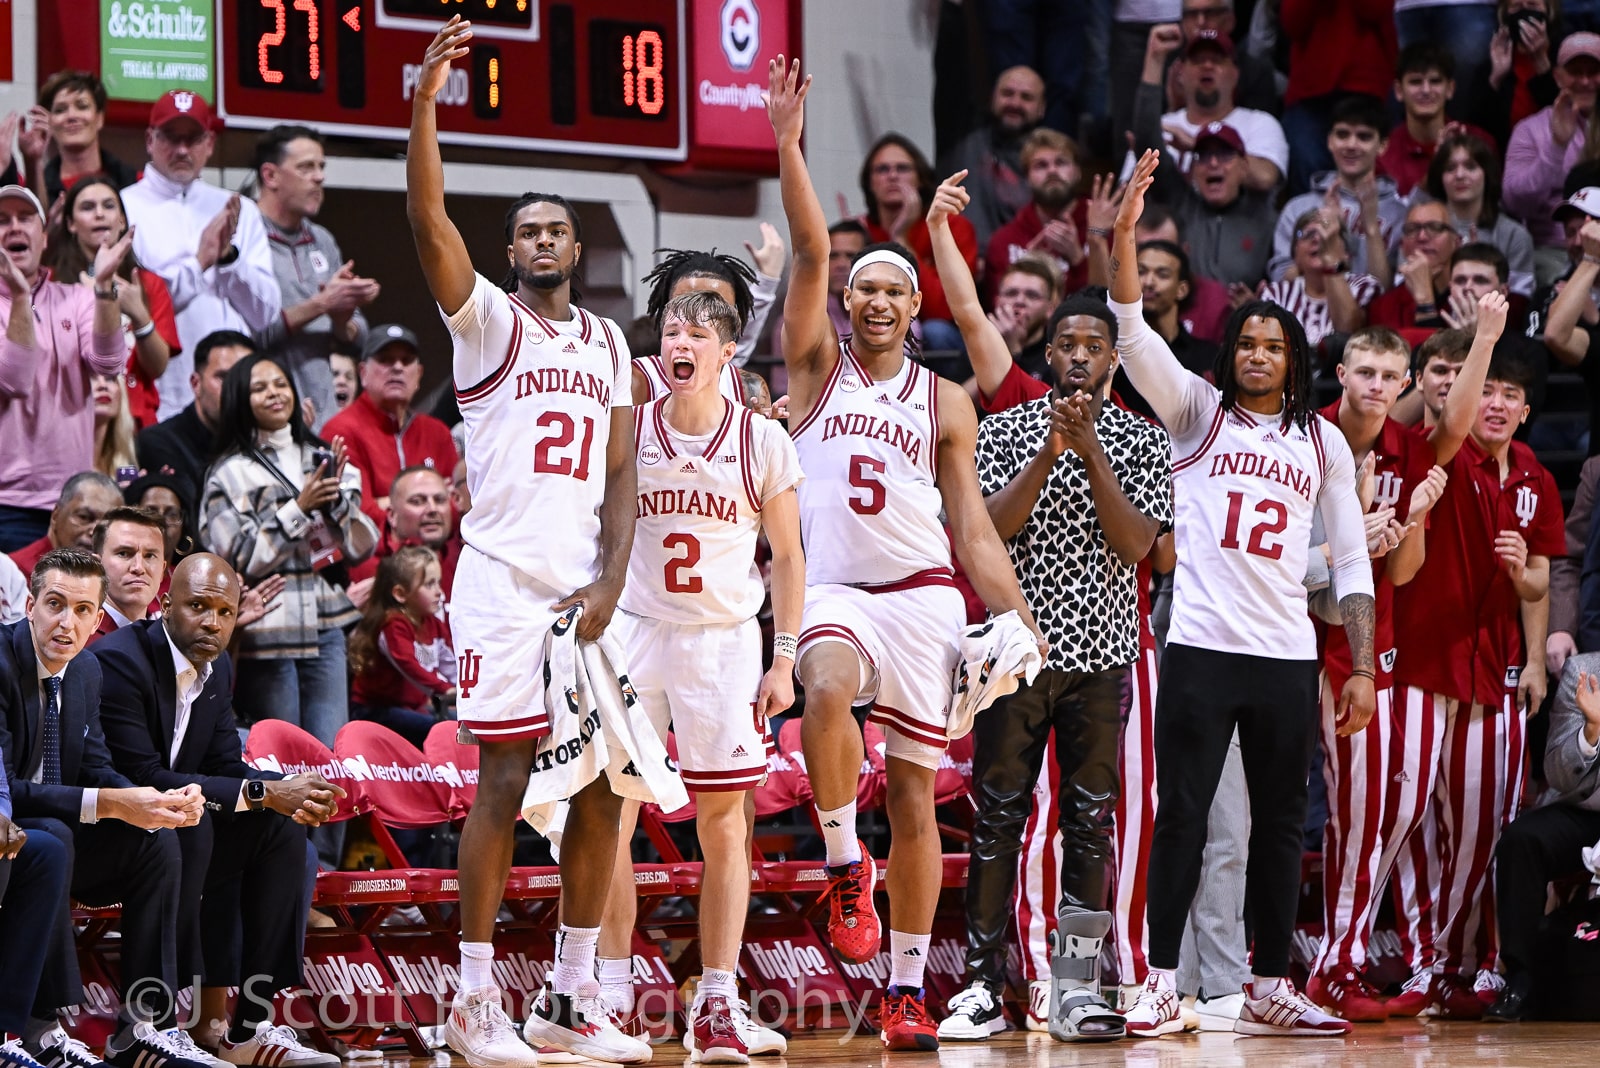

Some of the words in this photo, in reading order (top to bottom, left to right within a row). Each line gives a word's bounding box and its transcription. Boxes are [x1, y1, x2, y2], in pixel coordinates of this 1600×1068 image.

[258, 0, 320, 83] 27
[121, 60, 154, 79] TRIAL
[156, 62, 208, 82] LAWYERS
[489, 58, 499, 108] 1
[622, 30, 664, 115] 18
[515, 368, 610, 414] INDIANA
[534, 410, 594, 482] 21
[641, 450, 659, 460] RMK
[821, 413, 921, 467] INDIANA
[848, 454, 886, 516] 5
[1209, 452, 1312, 502] INDIANA
[636, 489, 738, 524] INDIANA
[1220, 491, 1289, 561] 12
[663, 532, 704, 594] 2
